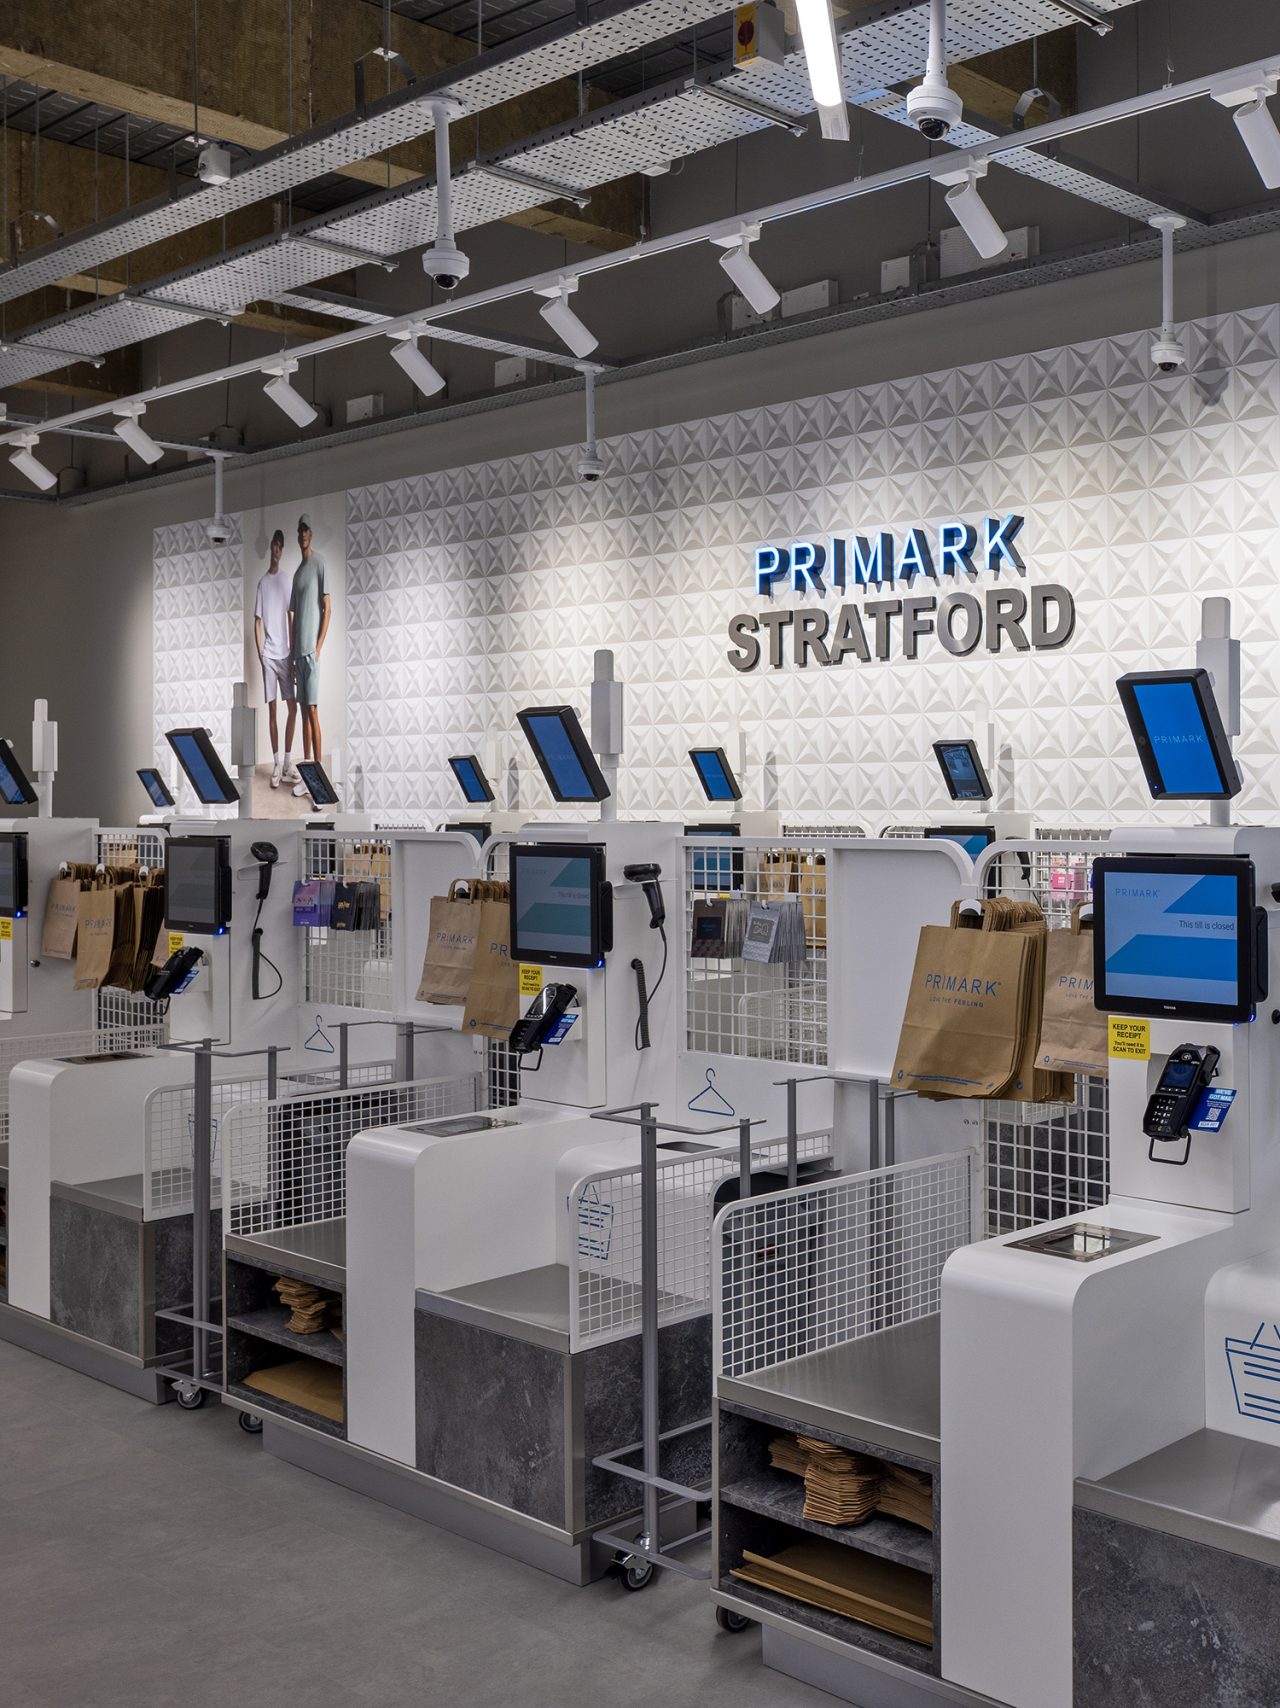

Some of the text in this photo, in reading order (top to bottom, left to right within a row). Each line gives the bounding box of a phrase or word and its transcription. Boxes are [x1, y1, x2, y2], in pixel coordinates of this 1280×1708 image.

[754, 513, 1027, 597] PRIMARK
[727, 584, 1076, 672] STRATFORD
[1153, 735, 1204, 745] PRIMARK
[1115, 888, 1159, 898] PRIMARK
[1179, 920, 1235, 930] This till is closed
[436, 932, 474, 944] PRIMARK
[925, 973, 997, 996] PRIMARK
[1058, 976, 1094, 990] PRIM
[954, 998, 984, 1008] FEELING
[1129, 1024, 1146, 1032] YOUR
[1116, 1031, 1142, 1039] RECEIPT
